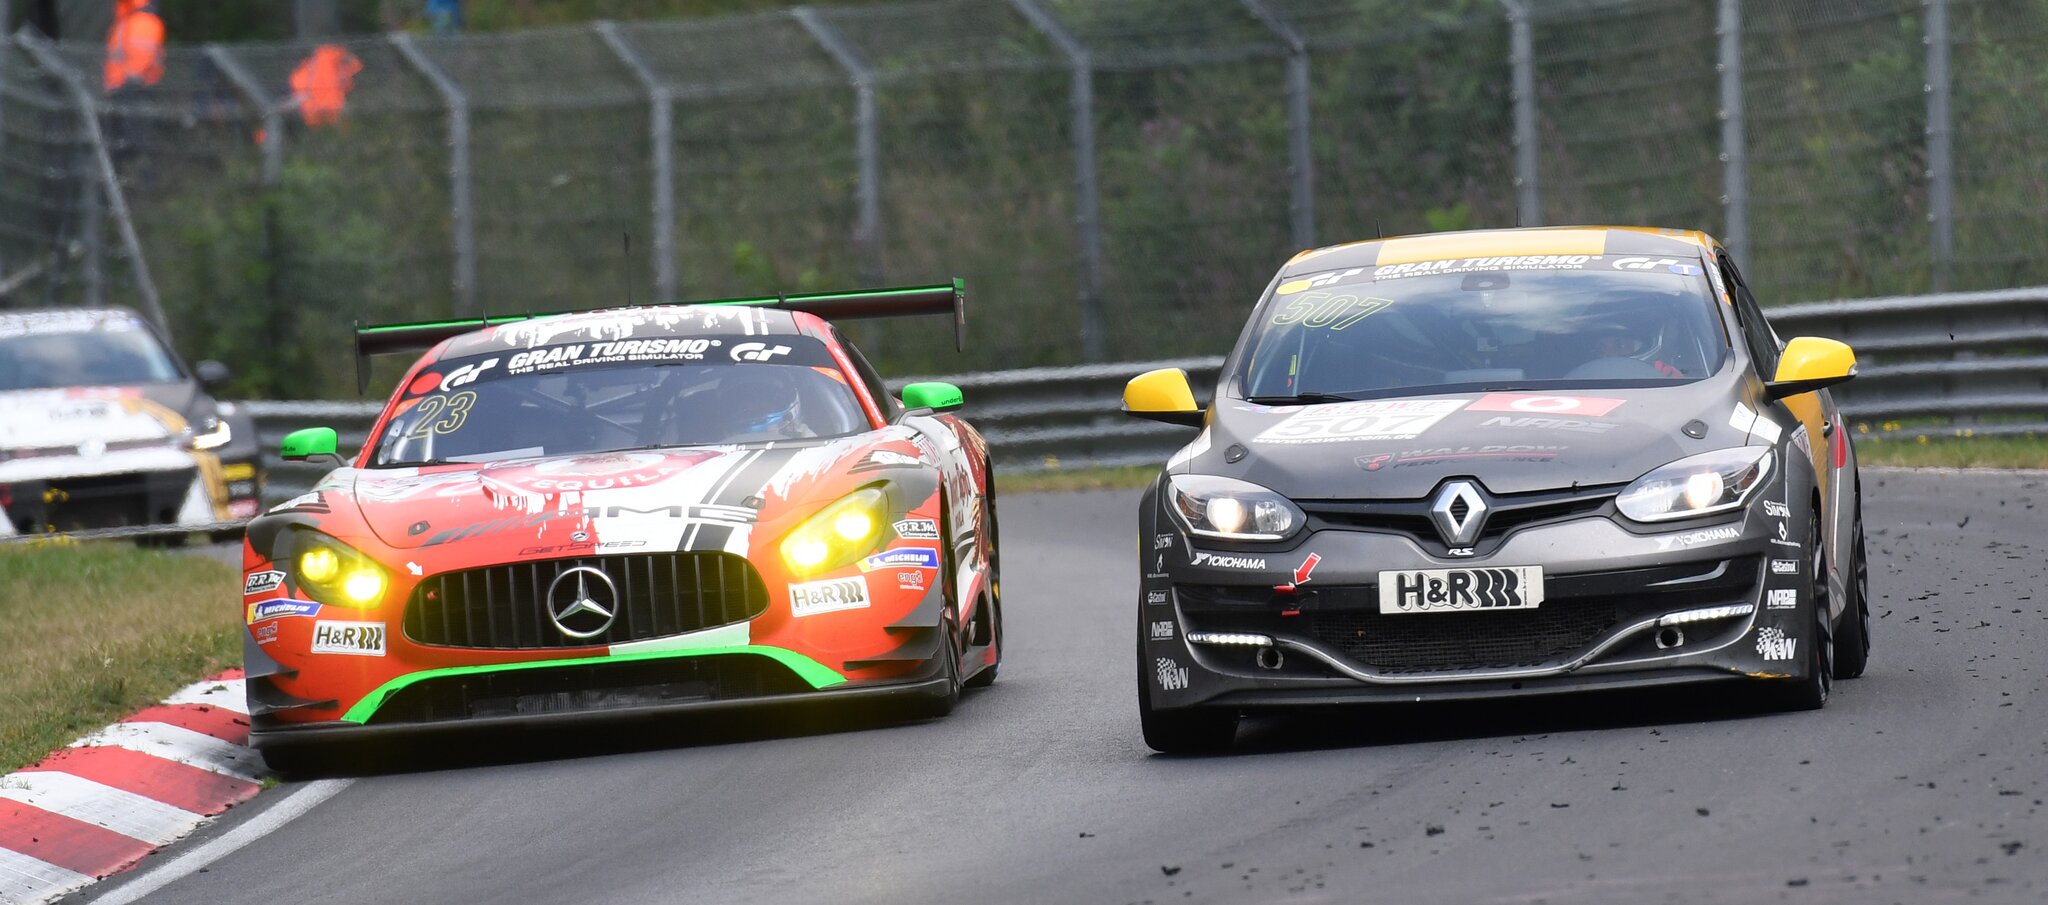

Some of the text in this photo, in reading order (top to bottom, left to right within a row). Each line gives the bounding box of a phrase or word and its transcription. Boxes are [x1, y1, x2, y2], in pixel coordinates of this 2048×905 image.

[1373, 255, 1590, 276] GRAN TURISMO
[1374, 263, 1583, 281] THE REAL DRIVING SIMULATOR
[1272, 291, 1394, 331] 507
[507, 343, 586, 369] GRAN
[509, 353, 704, 375] THE REAL DRIVING SIMULATOR
[406, 391, 477, 440] 23
[1274, 415, 1435, 436] 507
[518, 468, 681, 490] TEQUILA
[1676, 527, 1740, 546] YOKOHAMA
[885, 554, 930, 563] MICHELIN
[1447, 547, 1475, 556] RS
[1207, 555, 1266, 570] YOKOHAMA
[264, 604, 311, 615] MICHELIN
